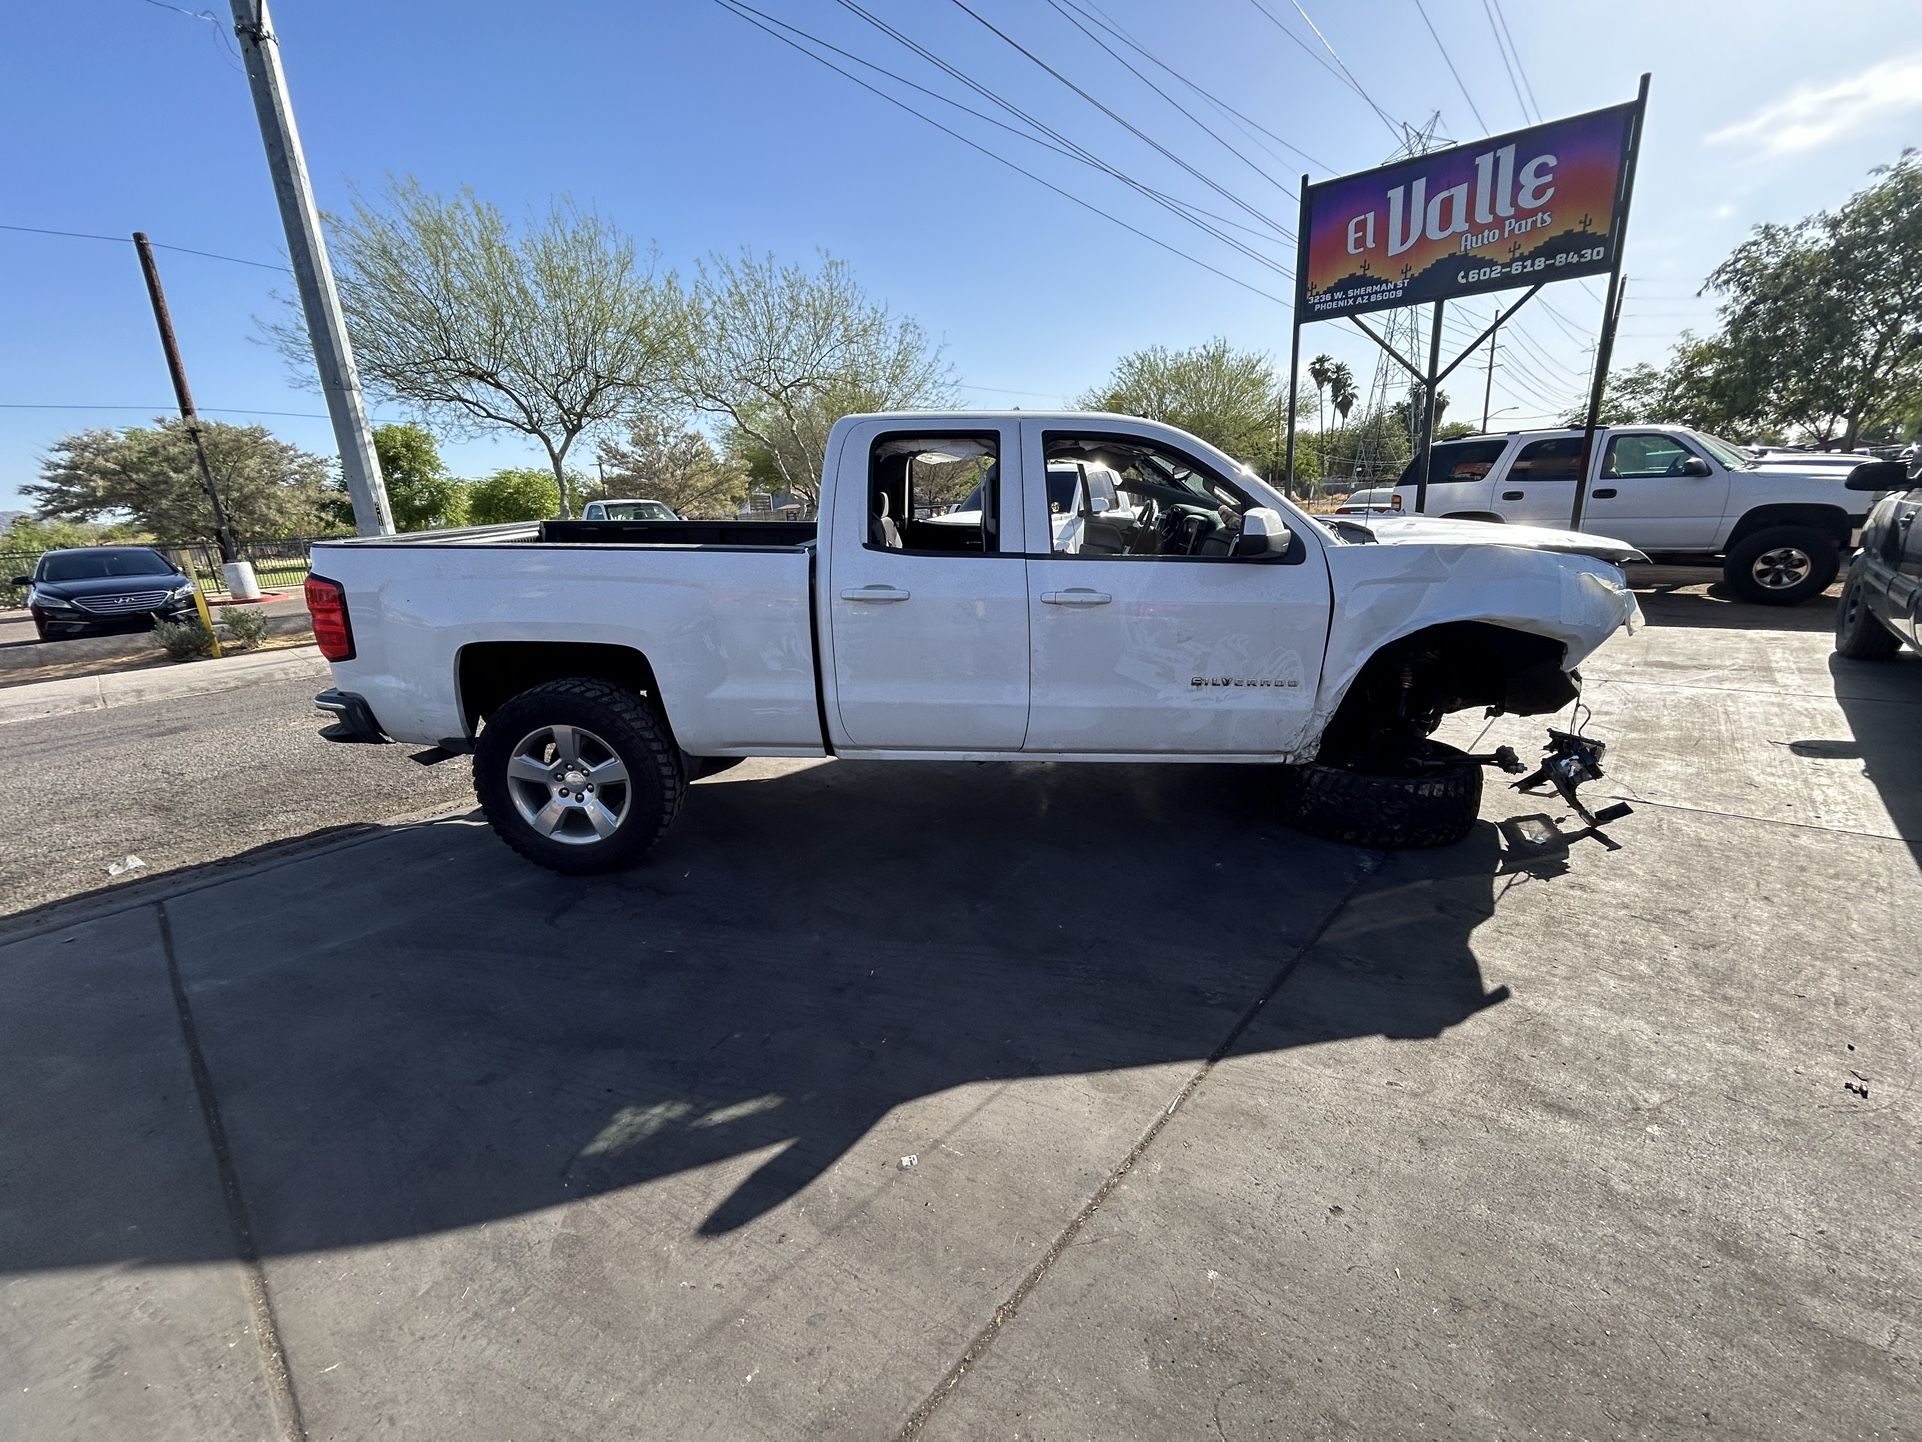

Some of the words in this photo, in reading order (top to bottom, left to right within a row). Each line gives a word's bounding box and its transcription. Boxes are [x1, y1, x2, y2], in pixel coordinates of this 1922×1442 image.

[1386, 143, 1558, 257] Valle
[1461, 229, 1499, 253] Auto
[1504, 211, 1552, 238] Parts
[1468, 246, 1605, 283] 602-618-8430
[1308, 293, 1332, 304] 3236
[1334, 291, 1345, 299] W.
[1347, 282, 1394, 297] SHERMAN
[1396, 279, 1410, 288] ST
[1314, 298, 1354, 311] PHOENIX
[1356, 295, 1369, 305] AZ
[1370, 289, 1403, 302] 85009
